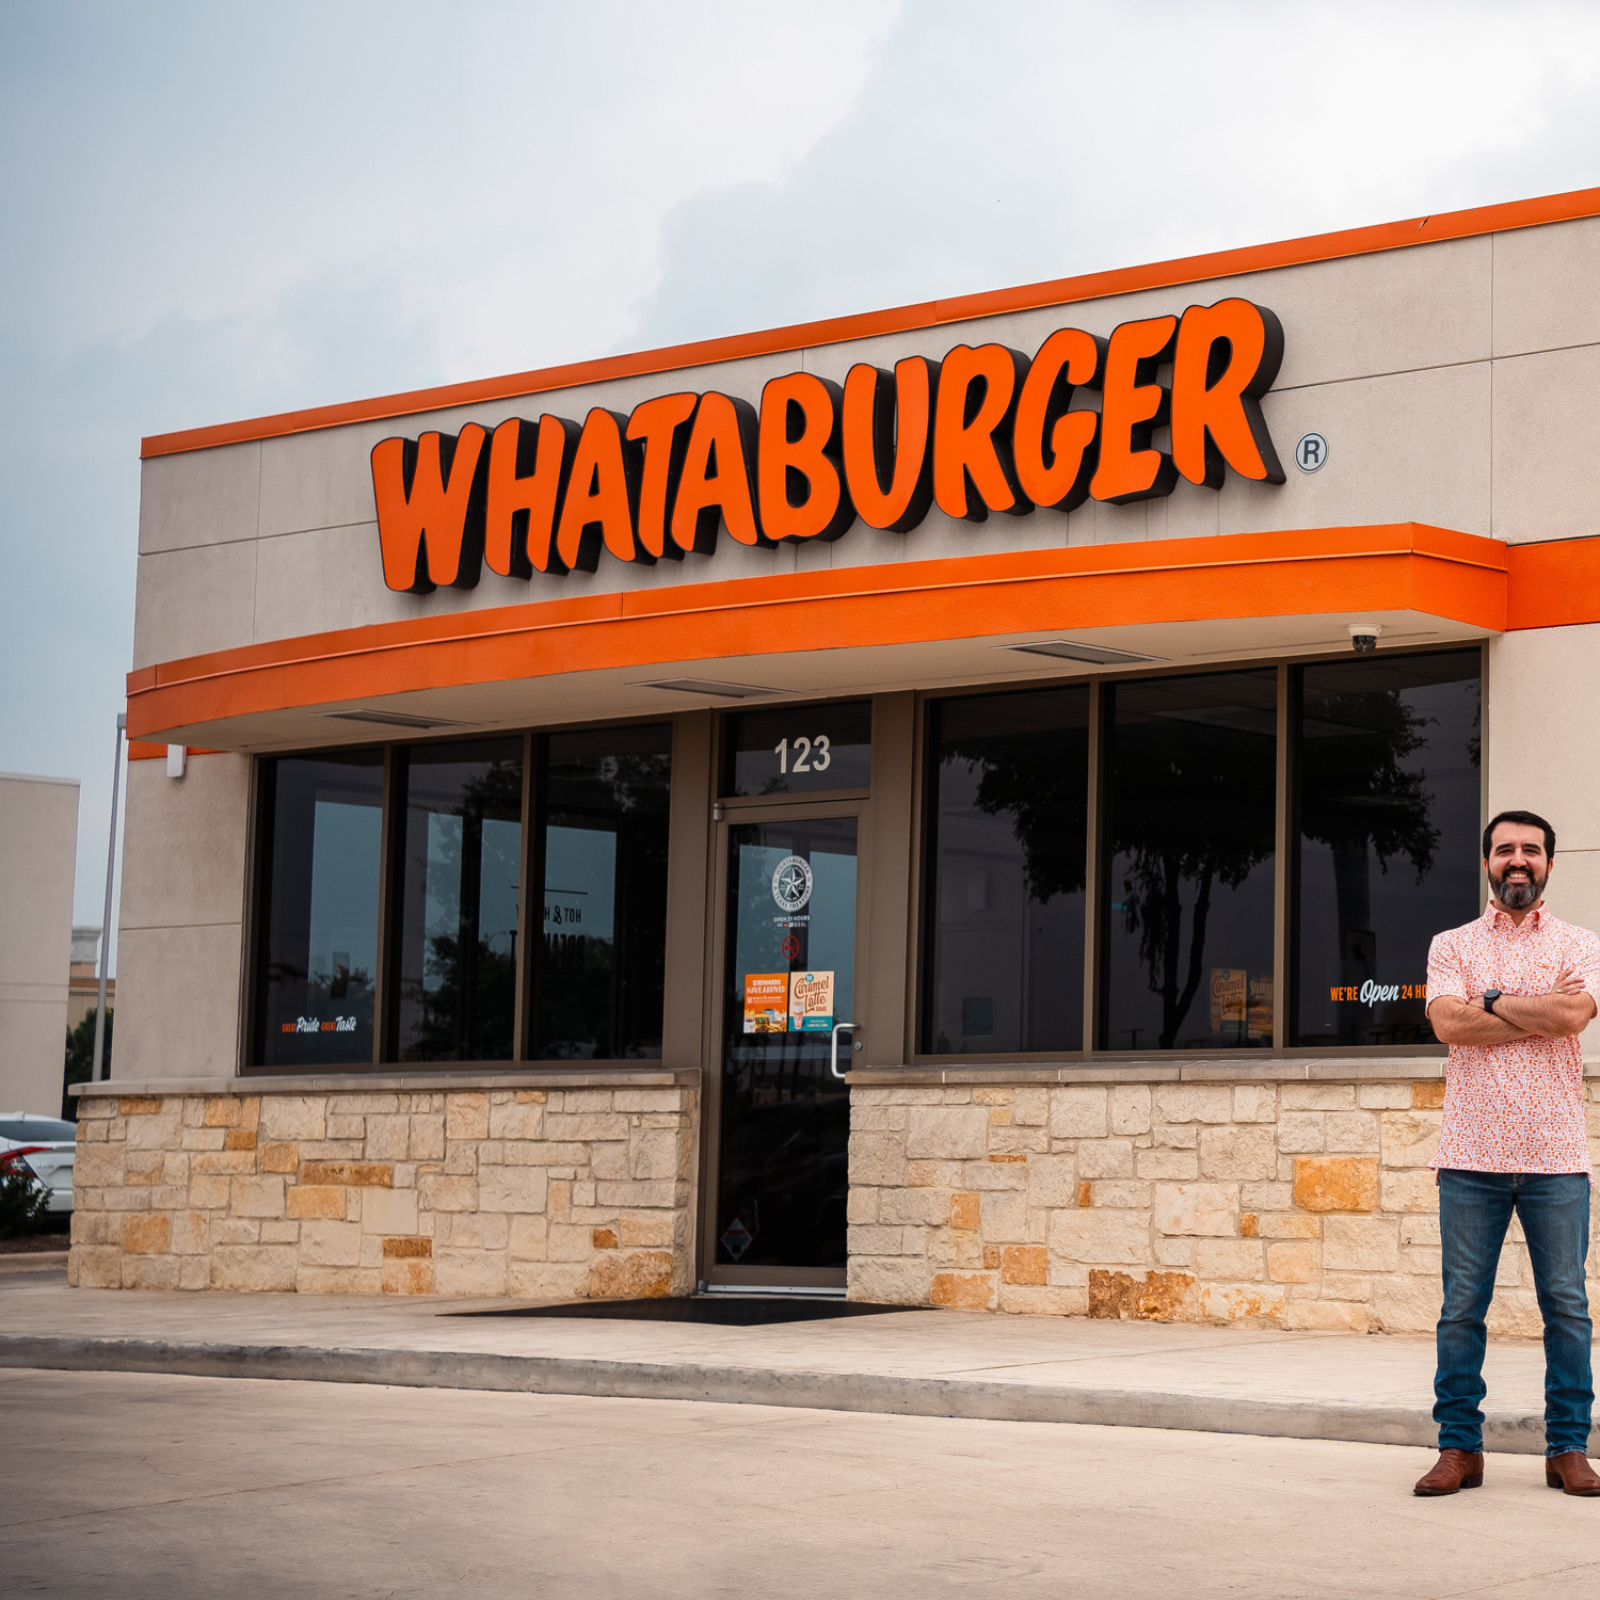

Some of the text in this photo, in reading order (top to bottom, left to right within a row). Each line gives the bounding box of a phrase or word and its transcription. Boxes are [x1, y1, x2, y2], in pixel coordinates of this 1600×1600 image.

[371, 297, 1286, 594] WHATABURGER
[775, 735, 830, 773] 123
[794, 975, 829, 999] Caramel
[1212, 975, 1245, 999] Caramel
[1330, 986, 1359, 1002] WE'RE
[1360, 979, 1399, 1008] Open
[1401, 984, 1414, 999] 24
[805, 991, 828, 1014] Latte
[1222, 992, 1244, 1016] Latte
[296, 1016, 320, 1033] Pride
[321, 1021, 336, 1031] GREAT
[336, 1015, 357, 1032] Taste
